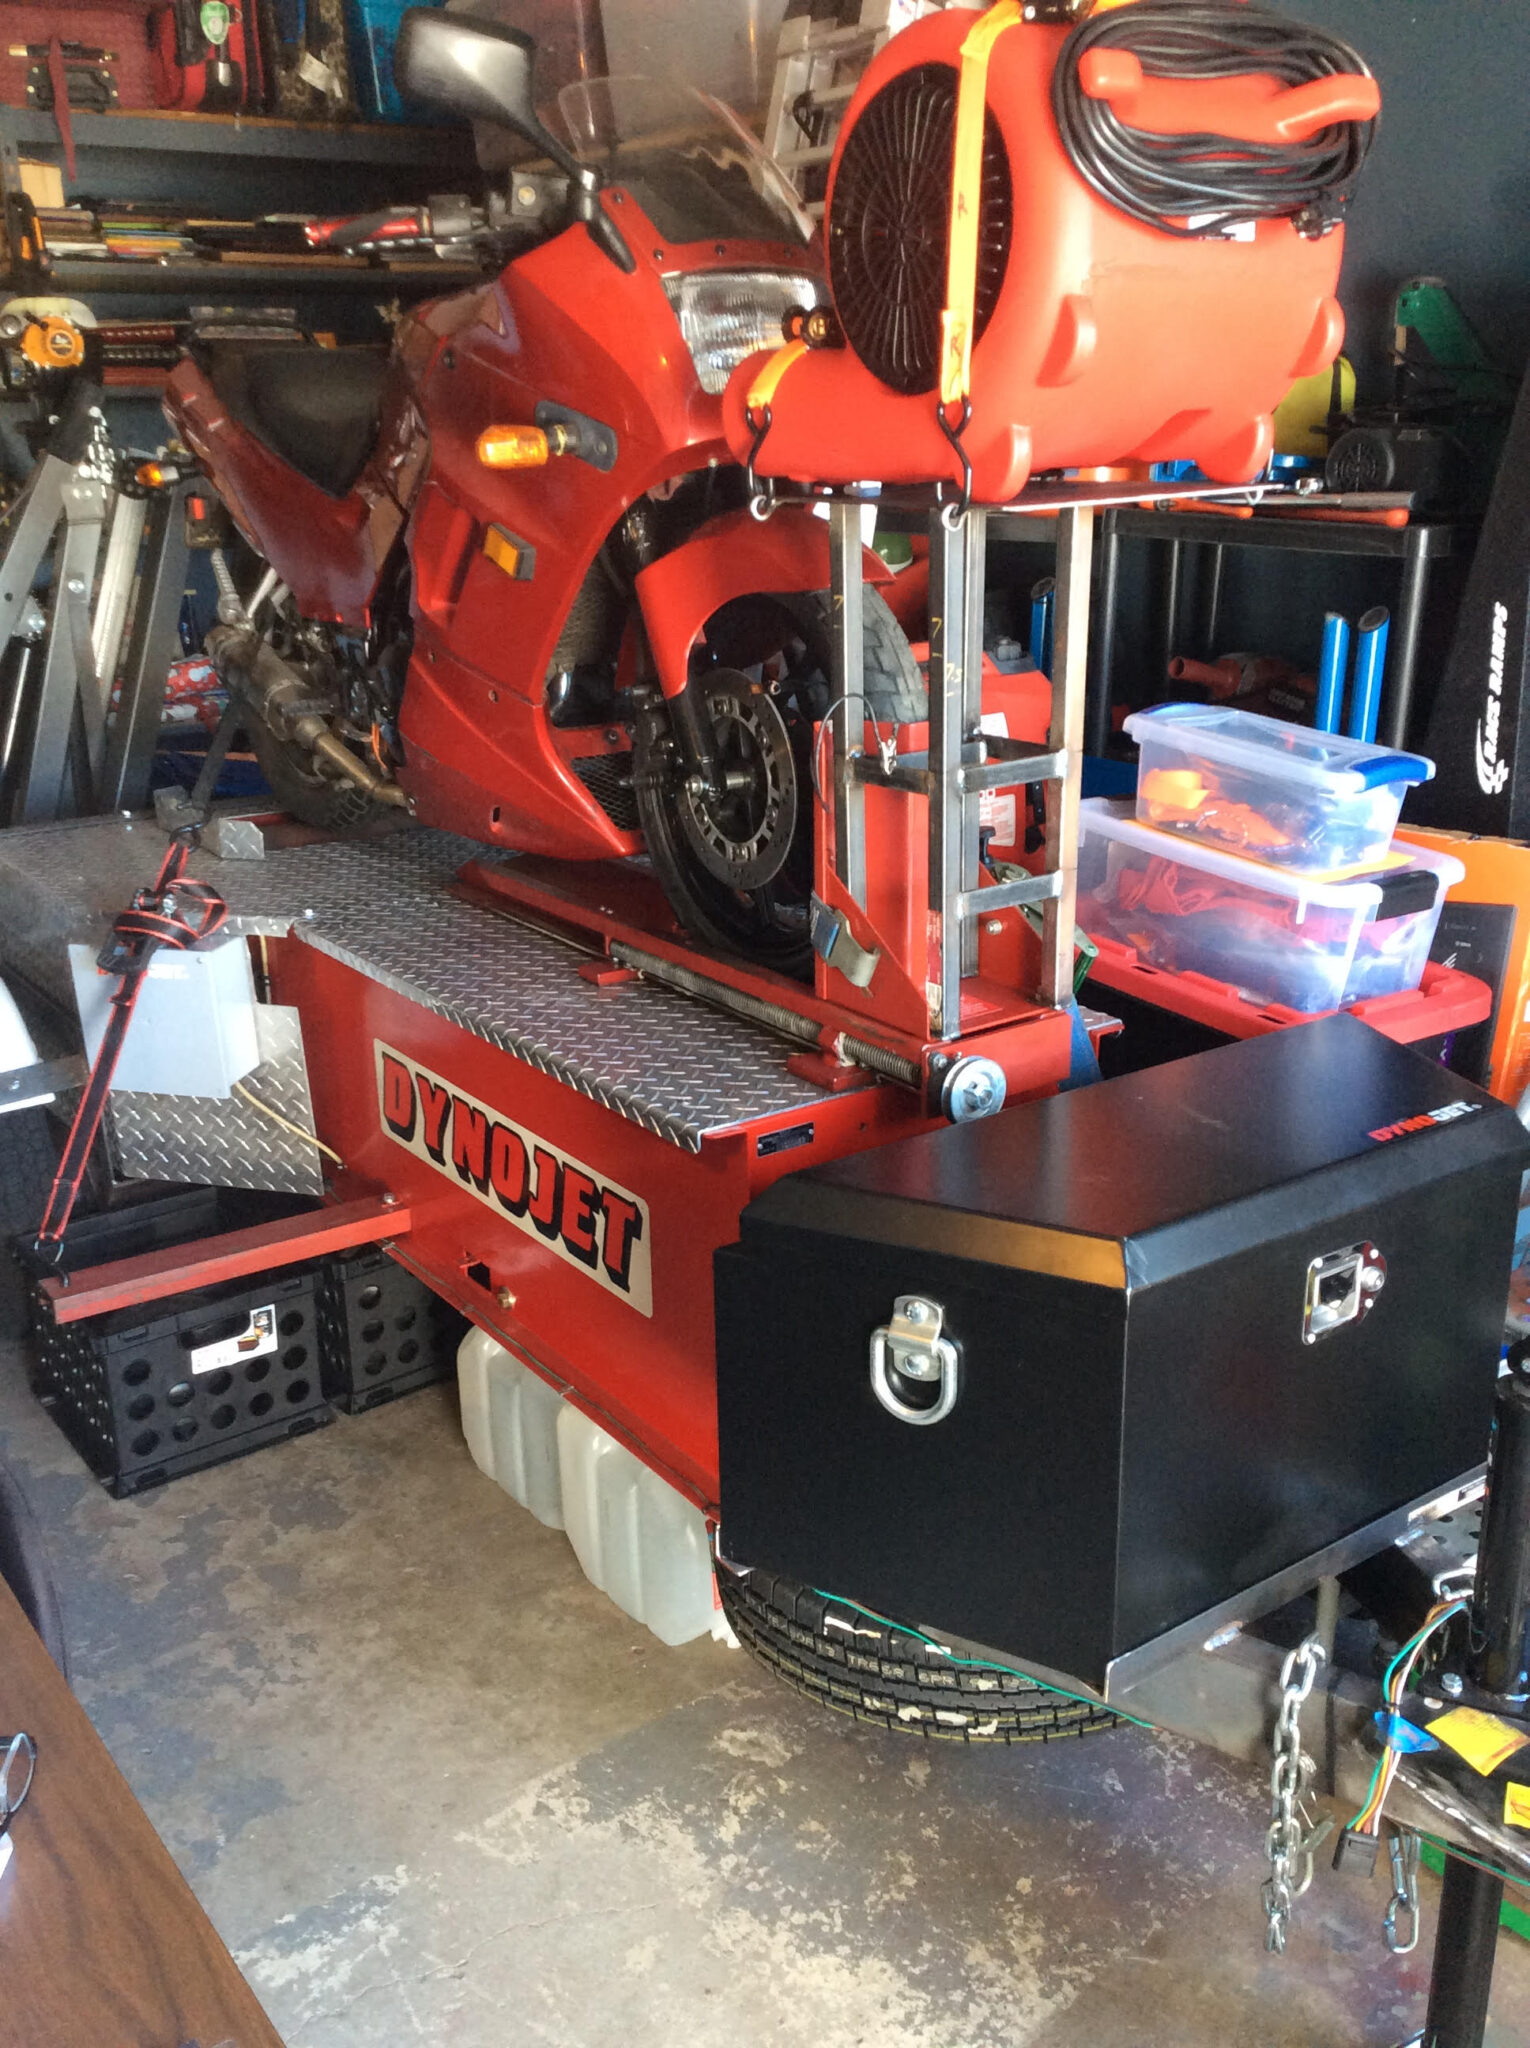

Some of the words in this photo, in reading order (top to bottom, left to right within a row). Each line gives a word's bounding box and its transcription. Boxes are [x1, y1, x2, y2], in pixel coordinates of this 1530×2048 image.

[931, 617, 942, 639] 7
[1489, 601, 1508, 696] RAMPS
[382, 1051, 643, 1294] DYNOJET
